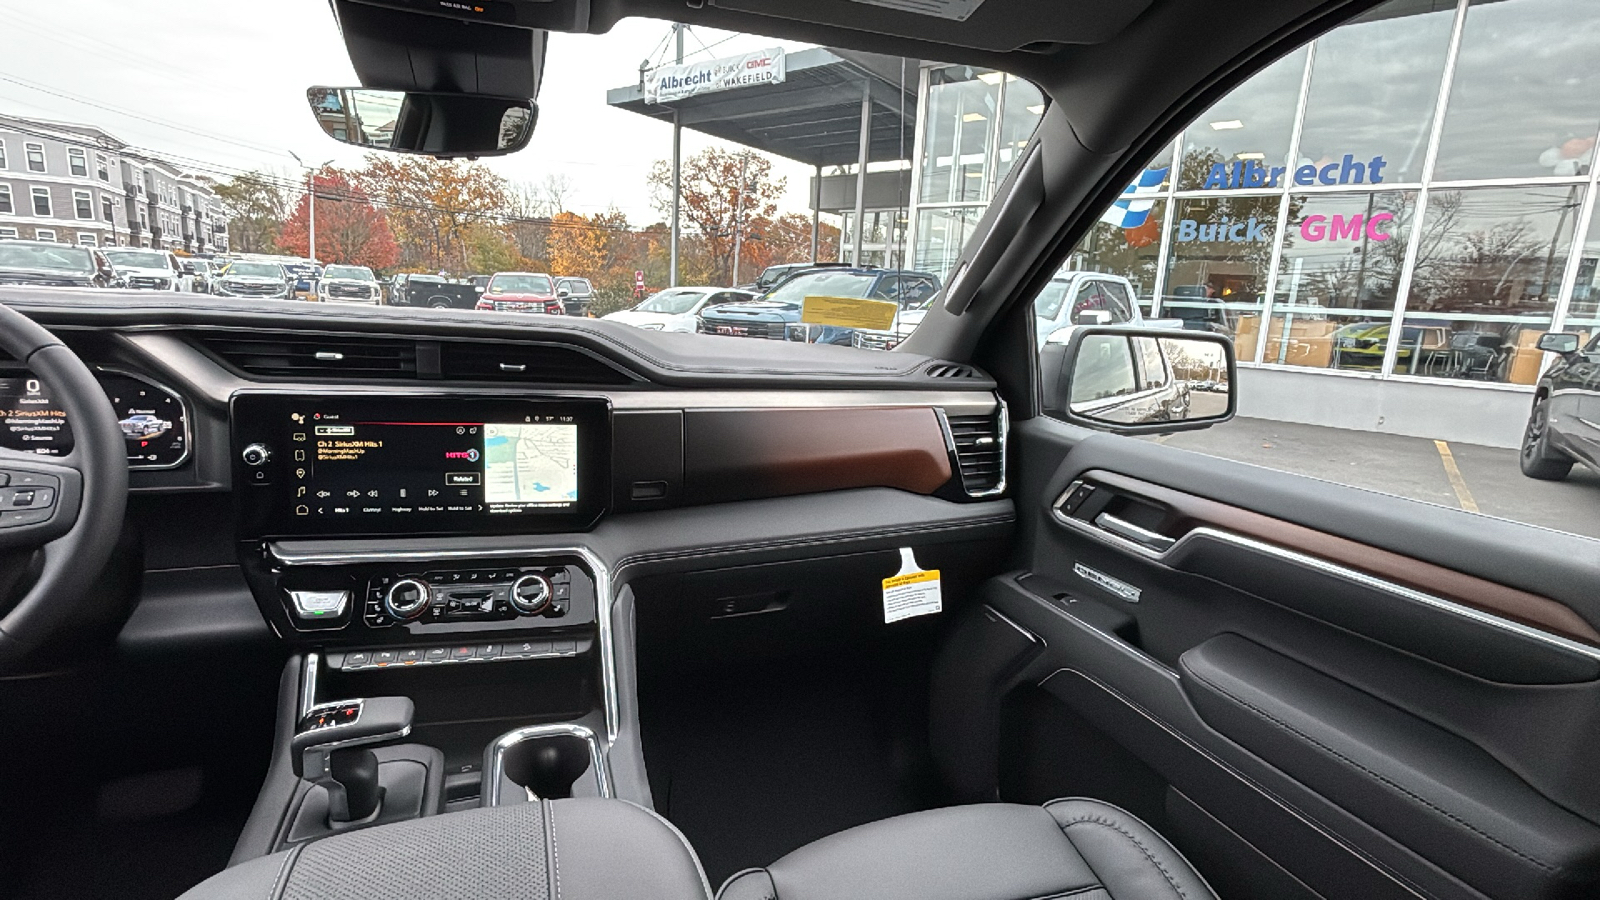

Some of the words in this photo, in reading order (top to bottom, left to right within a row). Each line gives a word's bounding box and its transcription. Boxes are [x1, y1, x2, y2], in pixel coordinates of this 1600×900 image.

[660, 69, 712, 90] Albrecht
[746, 57, 771, 69] GMC
[724, 71, 772, 87] WAKEFIELD
[1203, 154, 1387, 190] Albrecht
[1177, 216, 1267, 243] Buick
[1301, 212, 1394, 242] GMC
[14, 409, 49, 417] SiriusXM
[334, 440, 364, 448] SiriusXM
[364, 440, 378, 448] Hits
